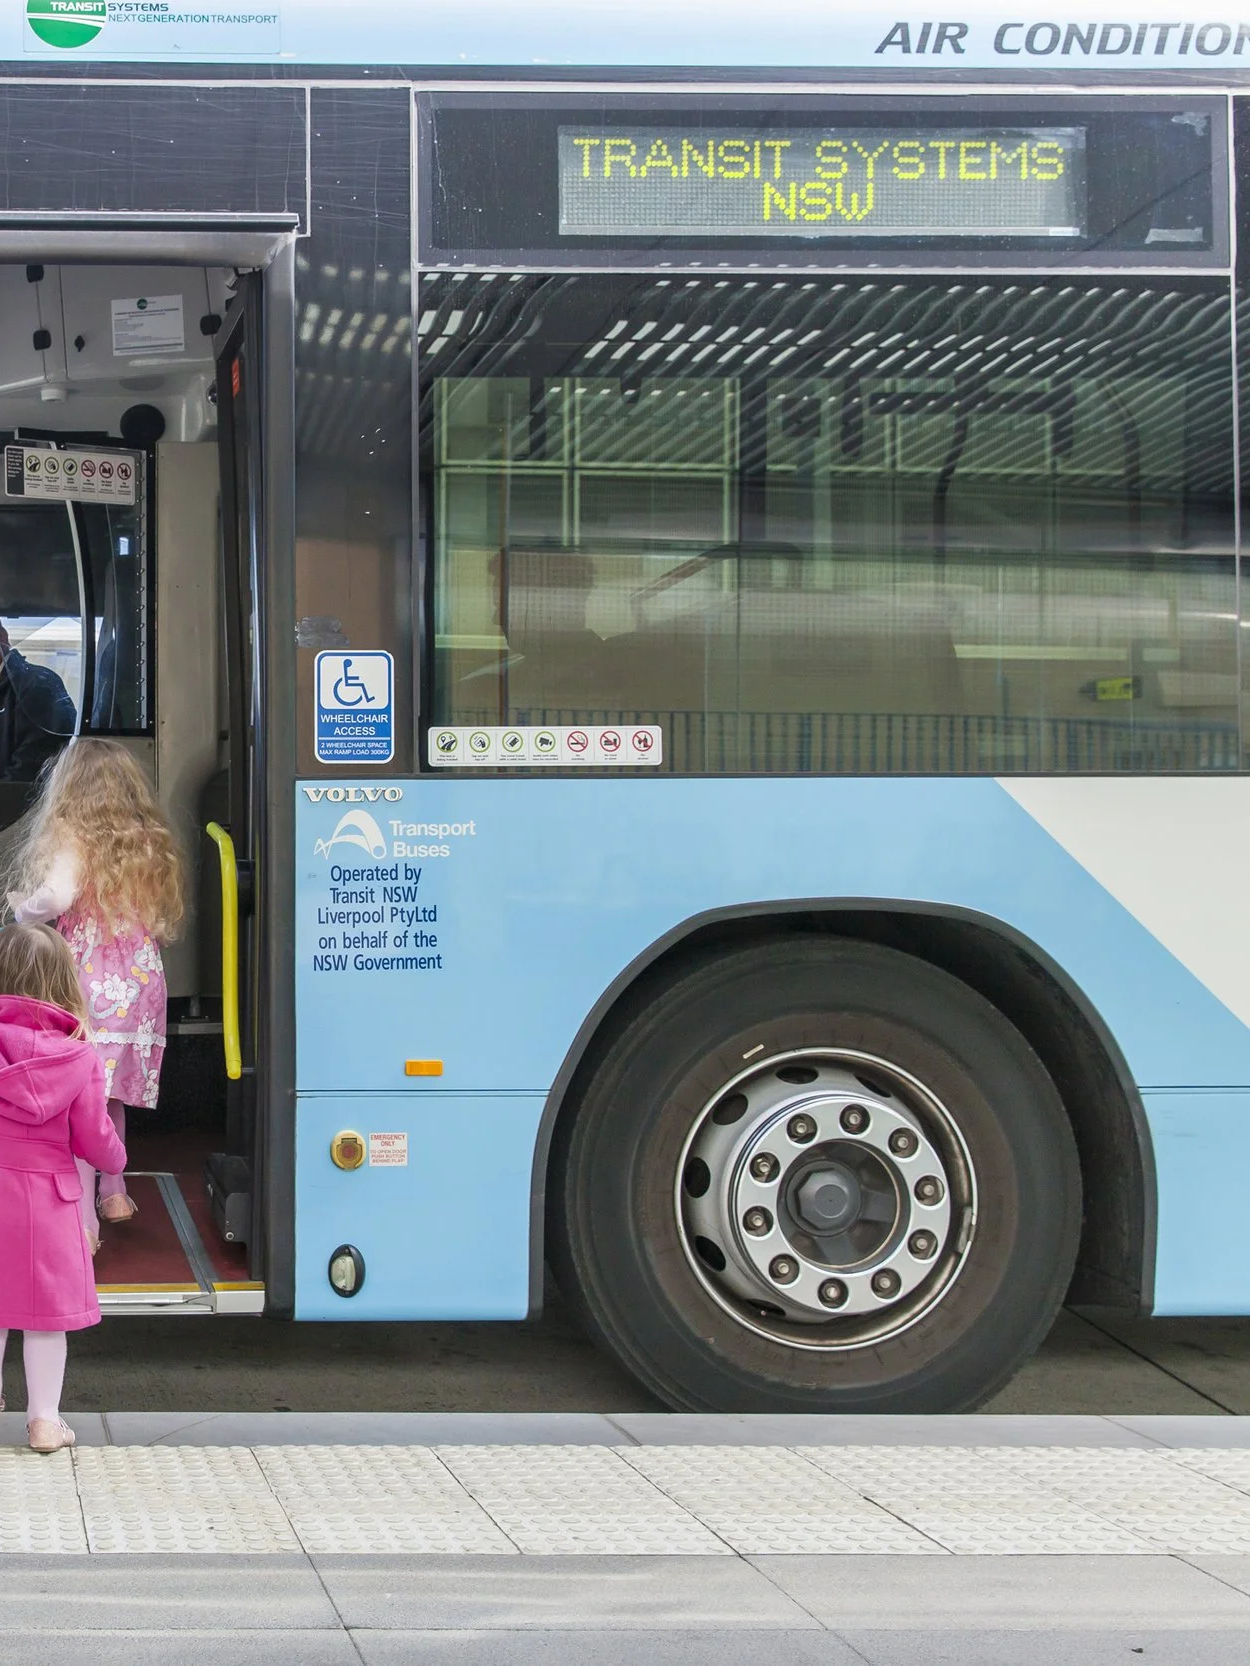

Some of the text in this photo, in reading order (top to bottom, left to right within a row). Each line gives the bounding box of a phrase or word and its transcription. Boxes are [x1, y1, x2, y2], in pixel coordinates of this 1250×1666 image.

[50, 1, 169, 12] TRANSIT SYSTEMS
[873, 22, 969, 55] AIR
[573, 138, 1065, 181] TRANSIT SYSTEMS
[762, 181, 875, 222] NSW
[320, 714, 388, 724] WHEELCHAIR
[333, 726, 376, 736] ACCESS
[302, 787, 403, 803] VOLVO
[389, 820, 476, 840] Transport
[393, 841, 450, 858] Buses
[330, 863, 422, 886] Operated by
[329, 886, 418, 904] Transit NSW
[317, 905, 385, 928] Liverpool
[318, 929, 438, 949] on behalf of the
[313, 953, 443, 971] NSW Government
